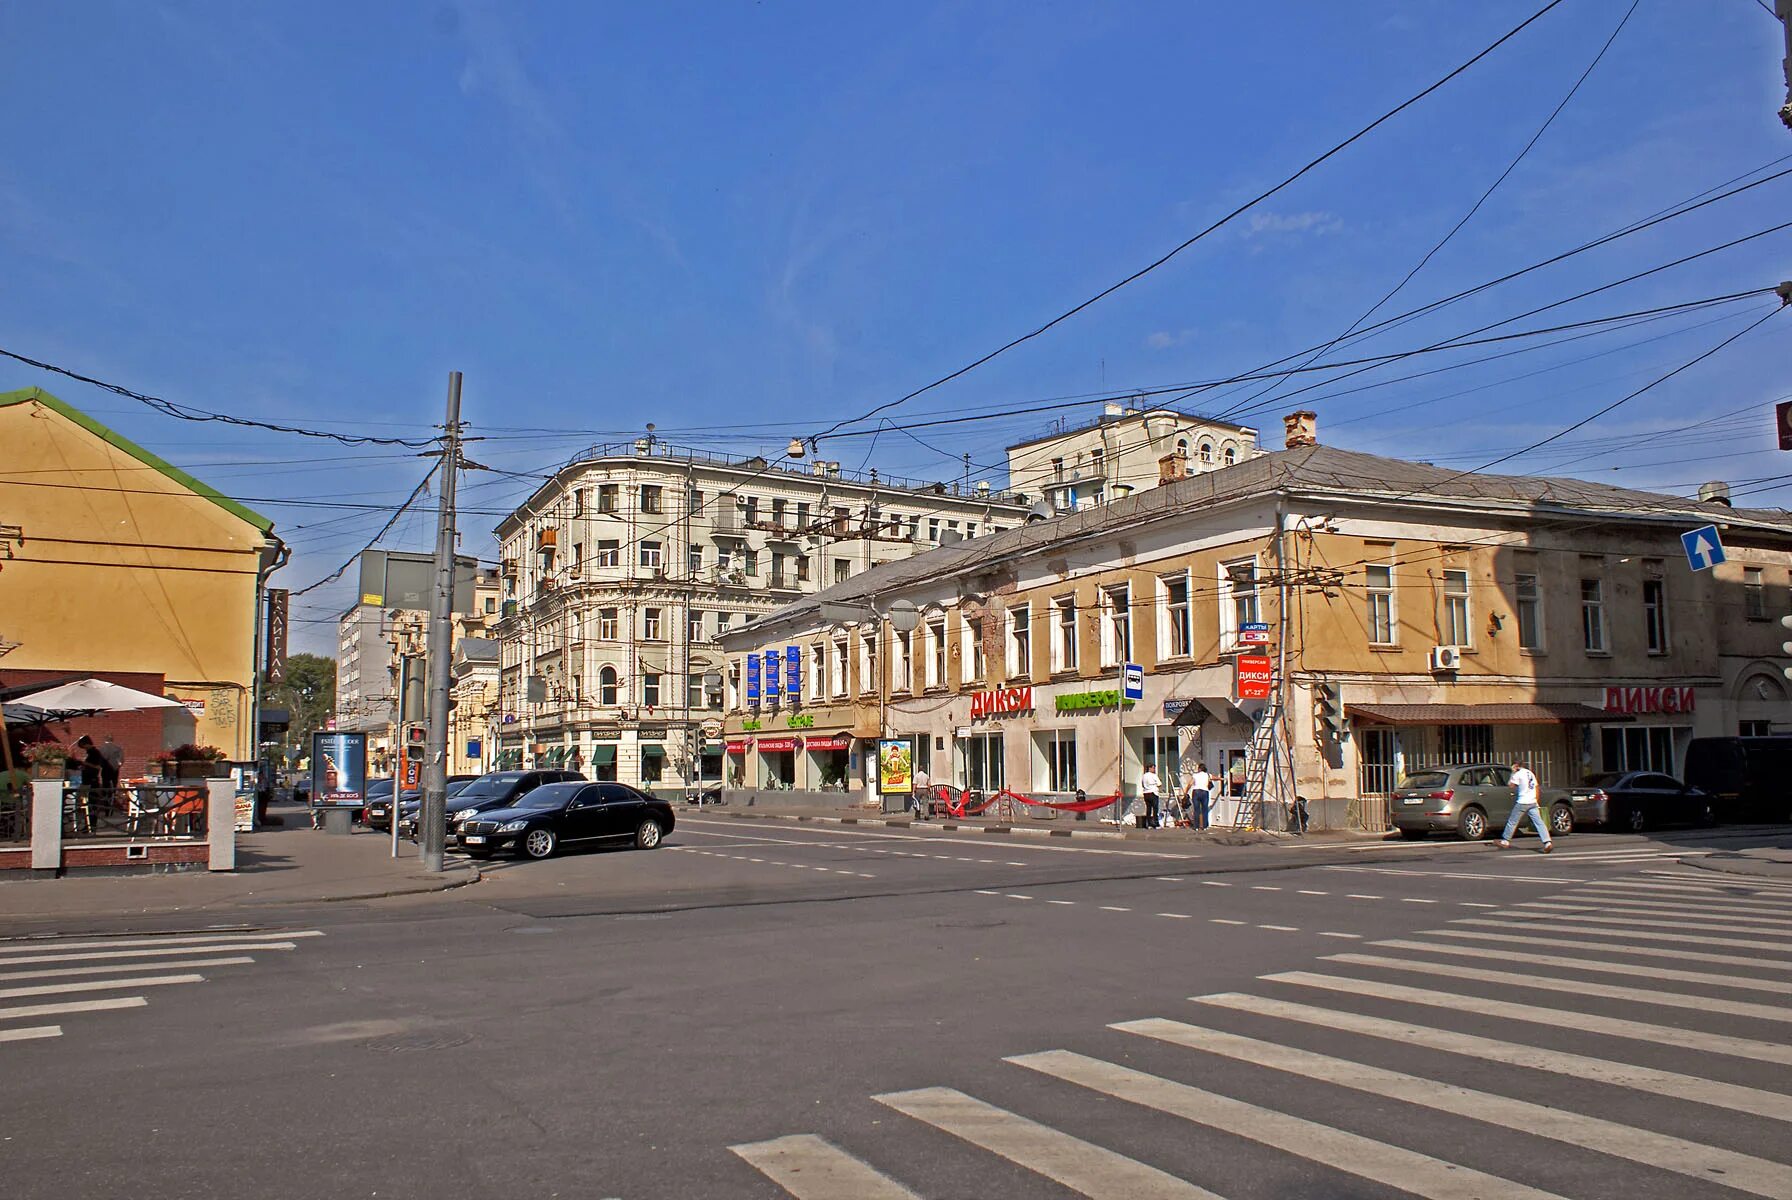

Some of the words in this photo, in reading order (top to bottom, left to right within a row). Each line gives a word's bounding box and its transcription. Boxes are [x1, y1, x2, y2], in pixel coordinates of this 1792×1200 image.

[271, 590, 283, 678] КАЛИГУЛА
[1238, 671, 1269, 681] ДИКСИ
[971, 687, 1033, 719] ДИКСИ
[1165, 701, 1191, 709] ПОКРОВК
[1604, 687, 1695, 713] ДИКСИ
